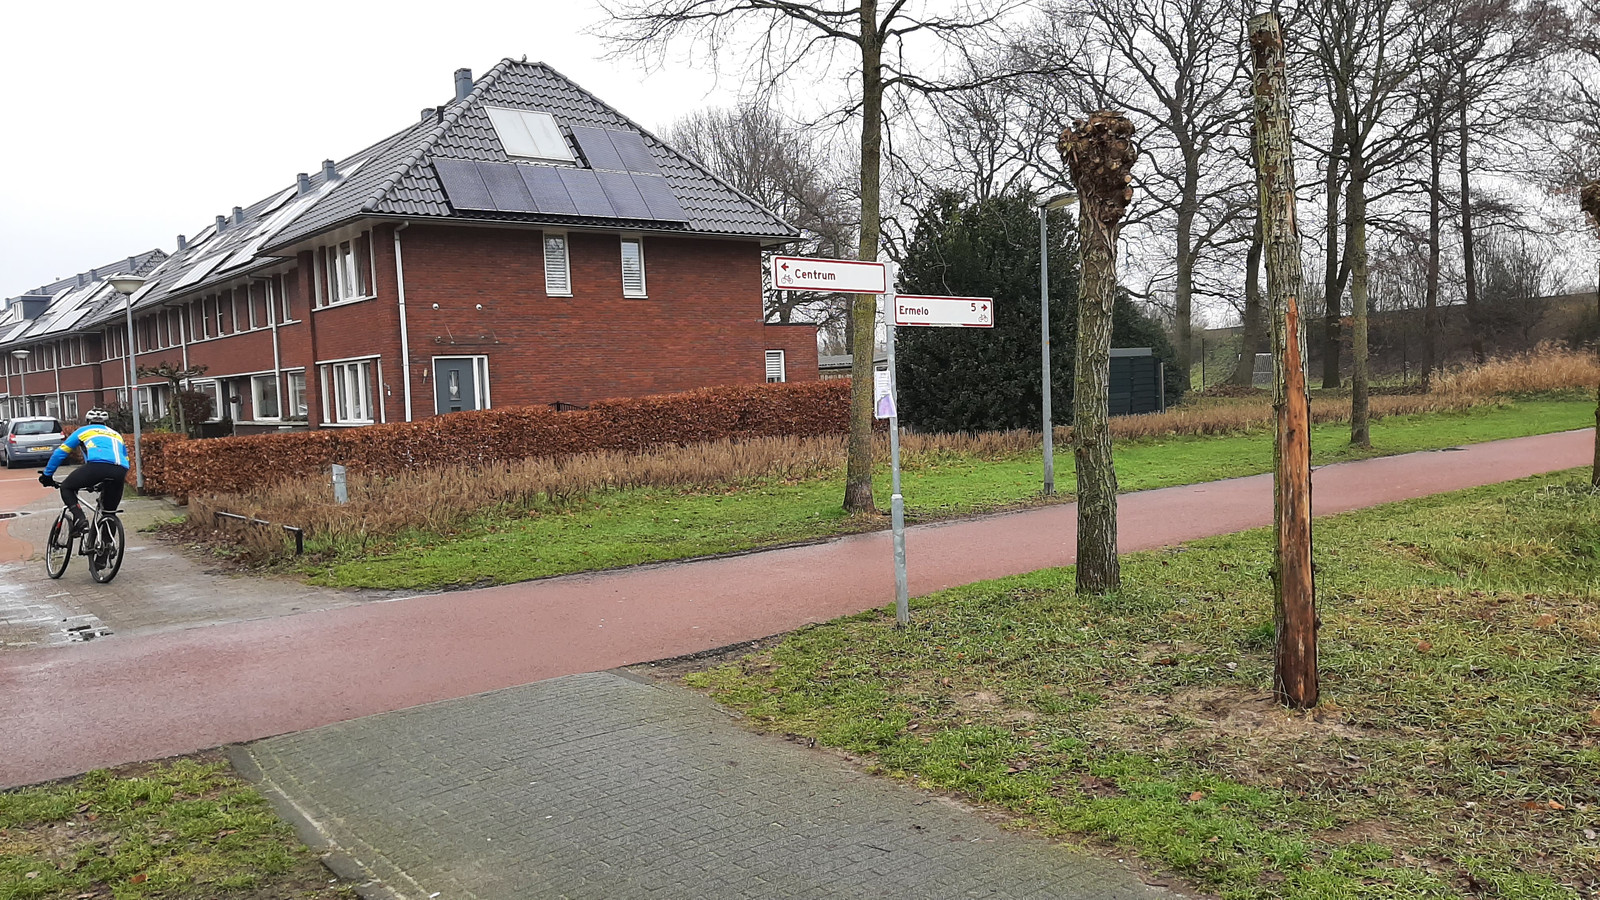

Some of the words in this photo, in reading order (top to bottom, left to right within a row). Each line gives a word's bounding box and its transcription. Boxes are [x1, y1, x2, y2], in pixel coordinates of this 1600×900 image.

[794, 268, 837, 281] Centrum
[899, 305, 930, 316] Ermelo
[970, 302, 978, 313] 5
